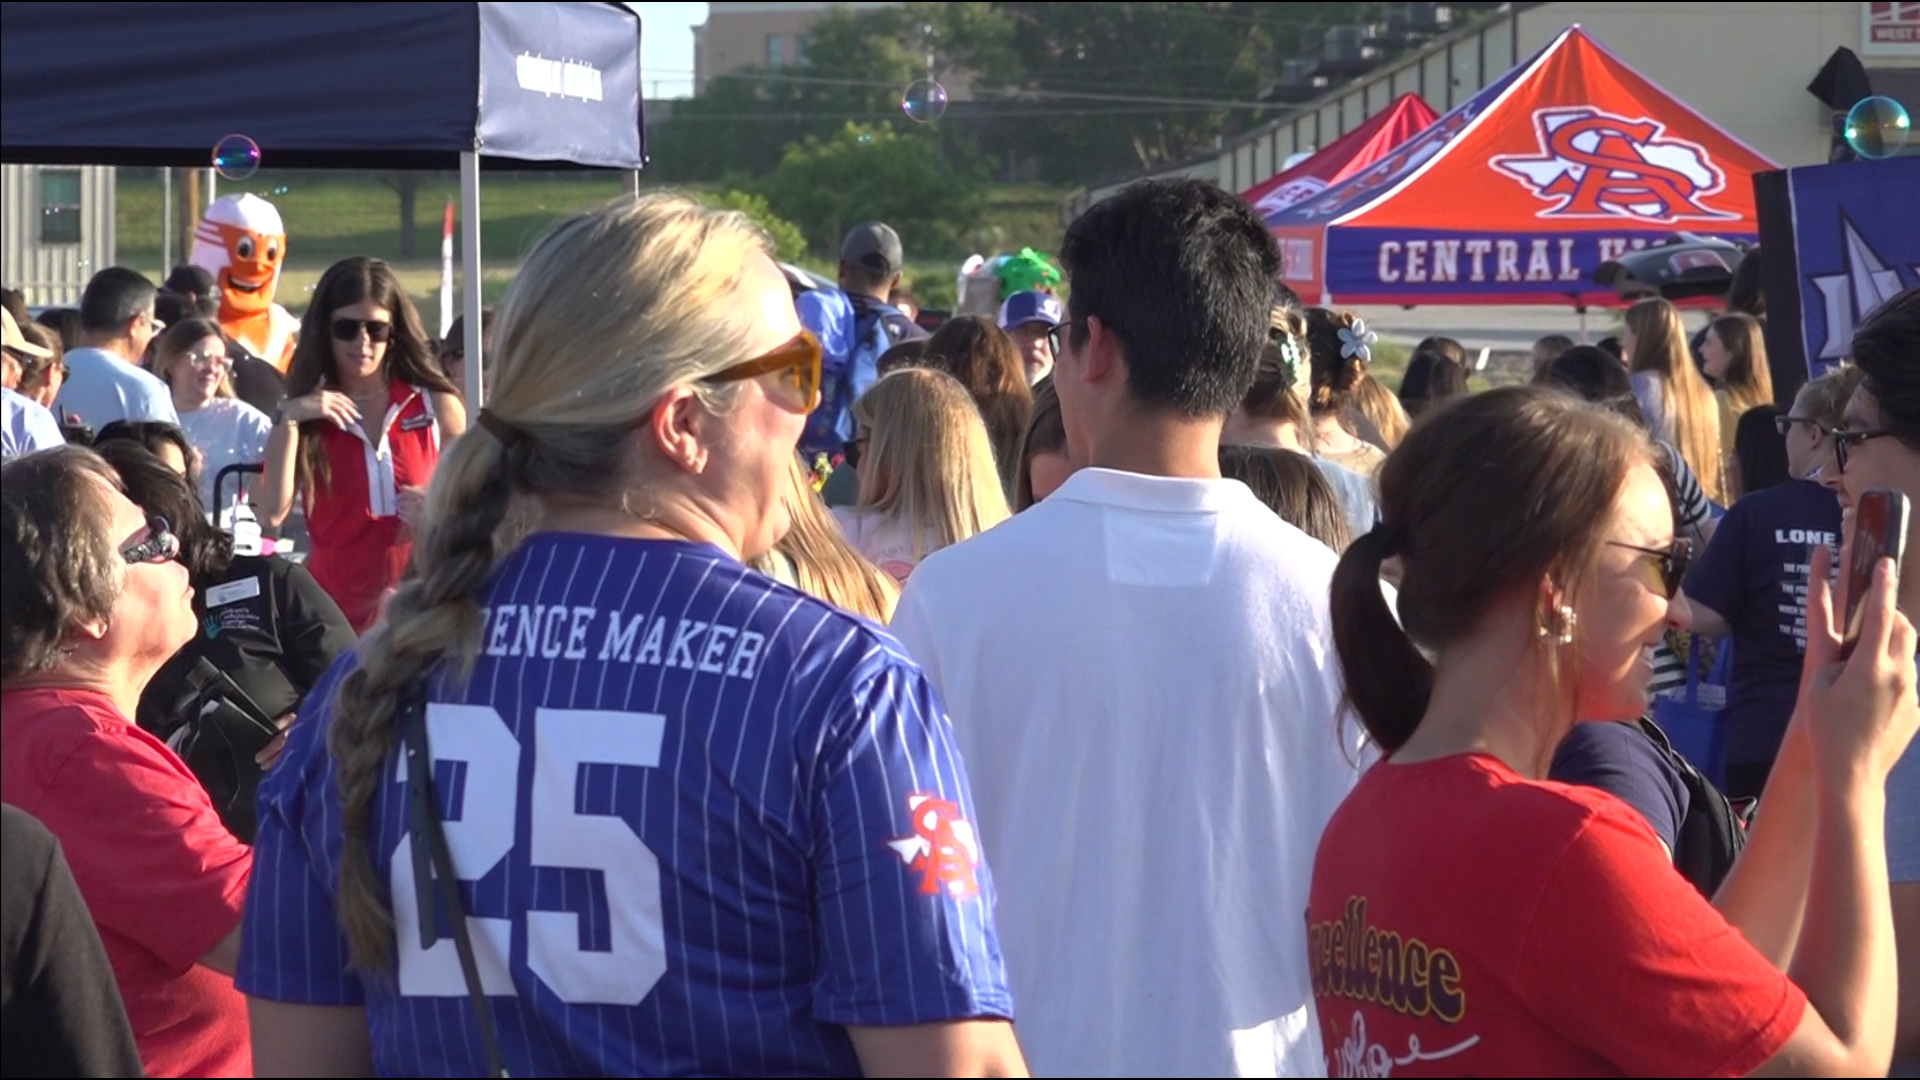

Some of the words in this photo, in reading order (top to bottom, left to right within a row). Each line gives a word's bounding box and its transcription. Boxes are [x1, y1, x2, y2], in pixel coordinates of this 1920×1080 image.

[1379, 239, 1580, 282] CENTRAL
[1775, 529, 1836, 546] LONE
[598, 610, 765, 680] MAKER
[391, 702, 667, 1006] 25
